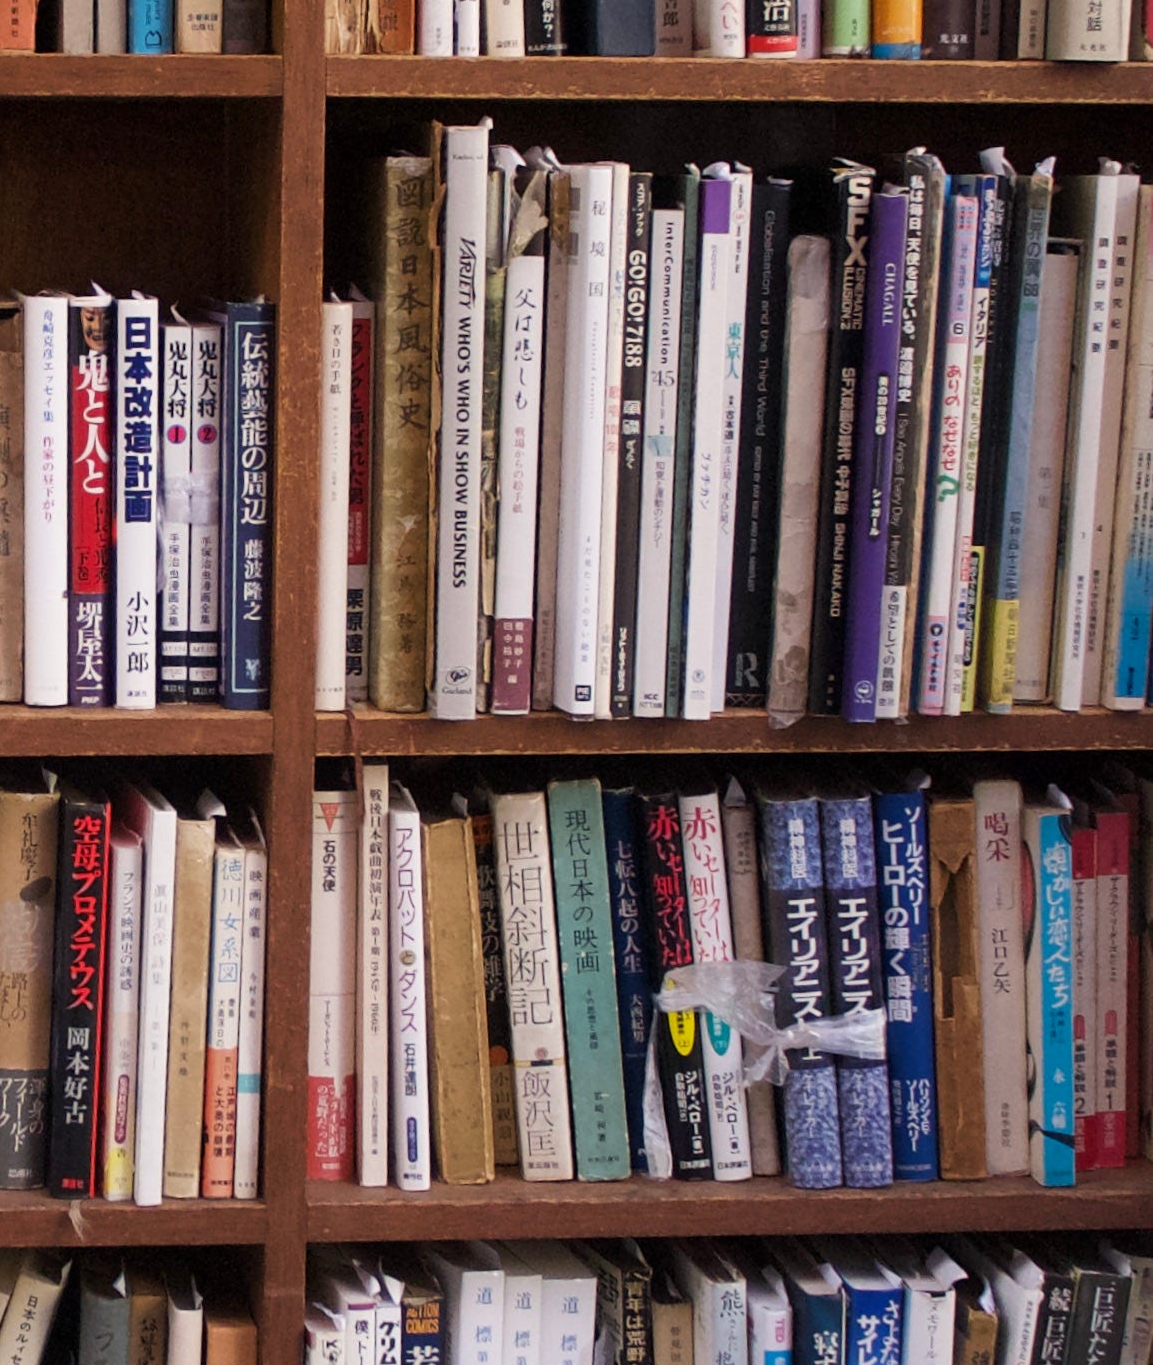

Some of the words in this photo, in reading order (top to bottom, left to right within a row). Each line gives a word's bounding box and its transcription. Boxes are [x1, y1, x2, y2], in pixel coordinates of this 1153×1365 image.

[845, 176, 872, 267] SFX
[459, 237, 476, 308] VARIETY
[625, 248, 647, 369] GO!GO!7188
[660, 222, 675, 366] InterCommunication
[881, 262, 896, 327] CHAGALL
[167, 340, 187, 419] 鬼丸大将
[197, 340, 218, 419] 鬼丸大将
[458, 316, 472, 370] WHO'S
[513, 287, 537, 412] 父は悲しも
[74, 351, 111, 495] 鬼と人と
[123, 317, 153, 524] 日本改造計画
[456, 411, 469, 429] IN
[457, 373, 471, 408] WHO
[455, 433, 469, 486] SHOW
[453, 489, 469, 589] BUSINESS
[75, 602, 103, 693] 堺屋太一
[126, 591, 150, 674] 小沢一郎
[322, 840, 337, 893] 石の天使
[905, 807, 925, 926] ソールズベリー
[984, 812, 1010, 862] 喝采
[67, 816, 102, 1010] 空母プロメテウス
[120, 871, 134, 990] フランス映画史の誘惑
[219, 858, 242, 983] 徳川女系図
[565, 809, 600, 975] 現代日本の映画
[882, 820, 913, 1023] ヒーローの輝く瞬間
[992, 928, 1011, 995] 江口乙矢
[64, 1027, 90, 1125] 岡本好古
[521, 1071, 556, 1158] 飯沢匡
[1075, 1097, 1085, 1114] 2
[378, 1321, 397, 1365] グリム
[406, 1318, 439, 1334] COMICS
[775, 1318, 786, 1343] TED
